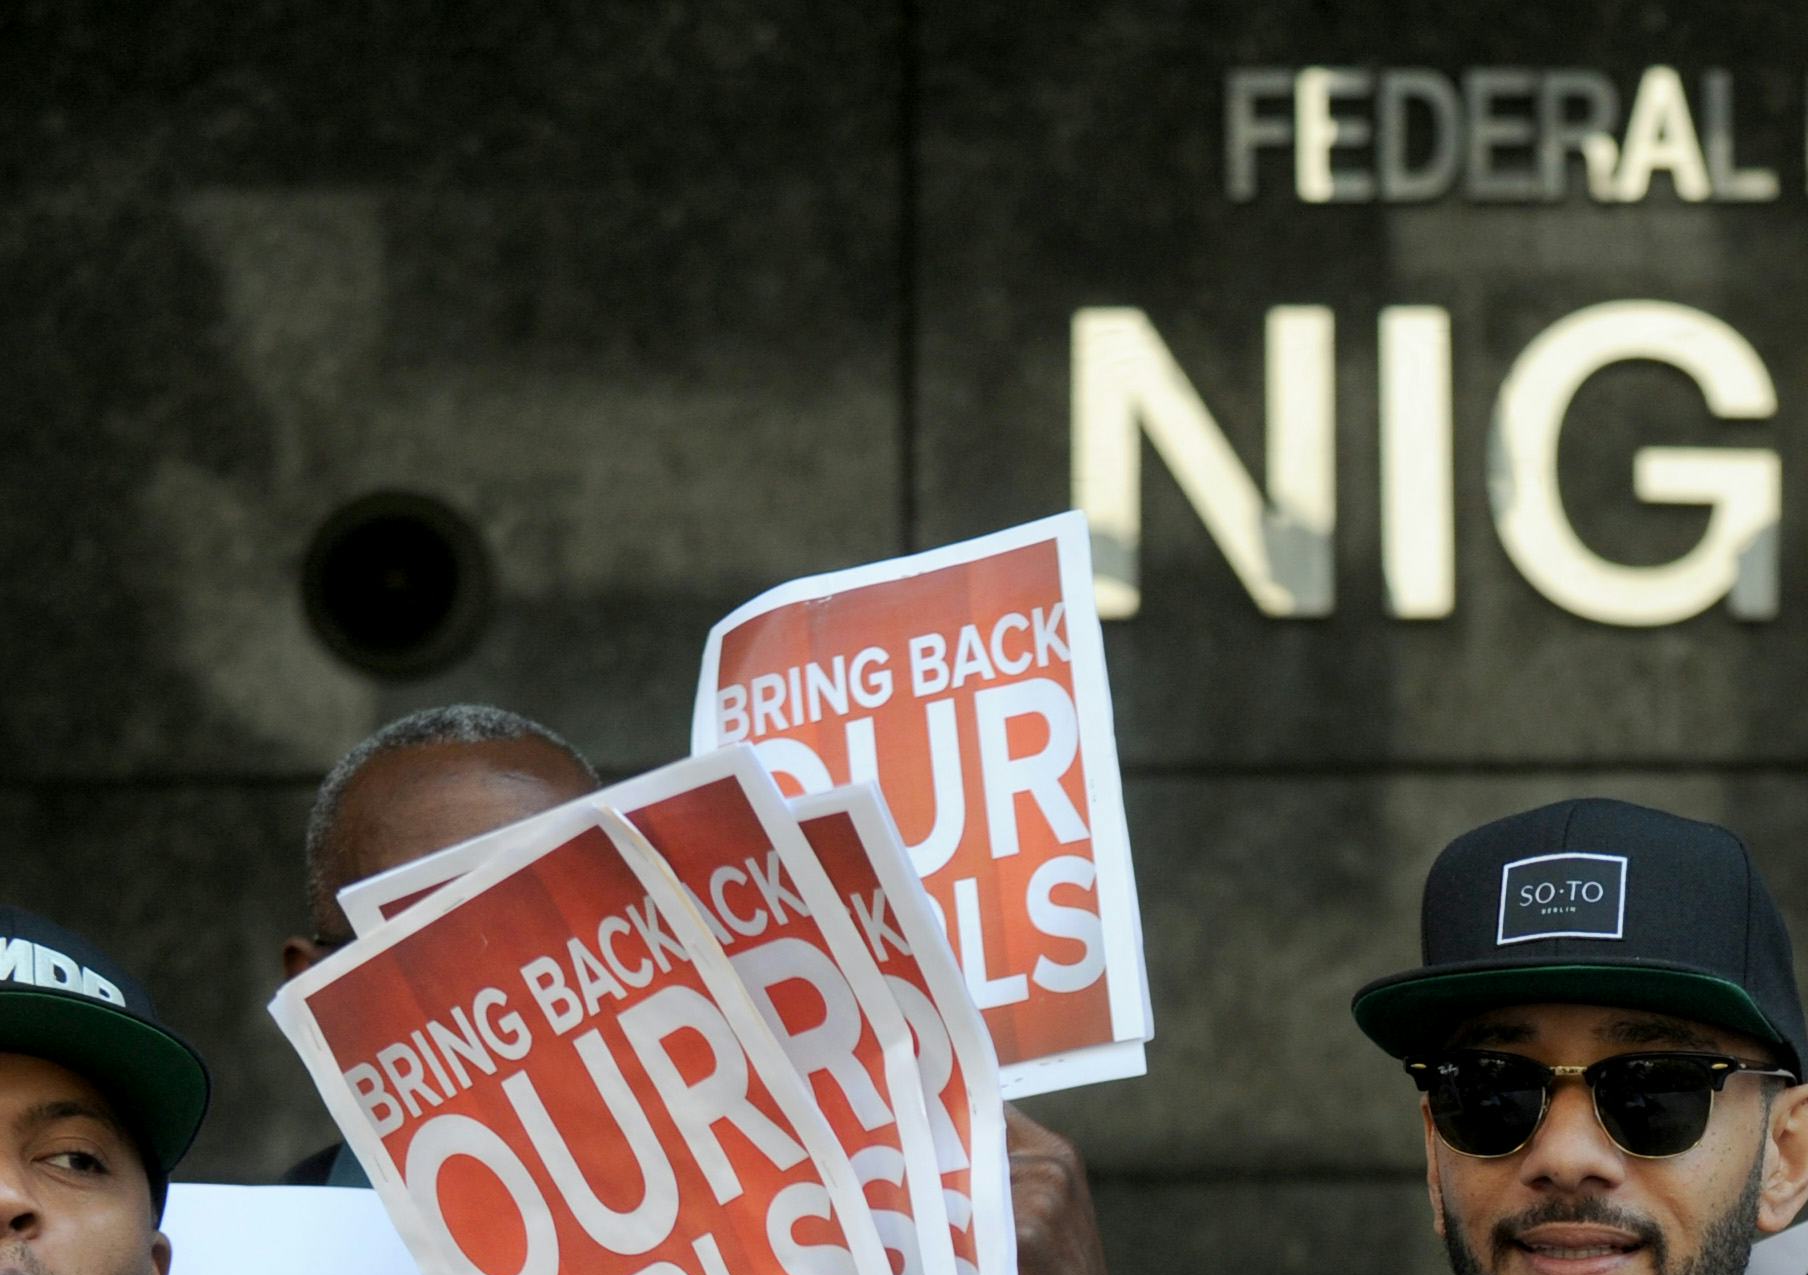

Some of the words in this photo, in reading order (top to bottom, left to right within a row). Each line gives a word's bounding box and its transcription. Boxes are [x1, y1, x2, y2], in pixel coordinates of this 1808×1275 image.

[1225, 66, 1780, 202] FEDERAL
[716, 646, 893, 744] BRING
[908, 601, 1072, 698] BACK
[749, 678, 1093, 880] UR
[344, 986, 532, 1139] BRING
[519, 895, 692, 1036] BACK
